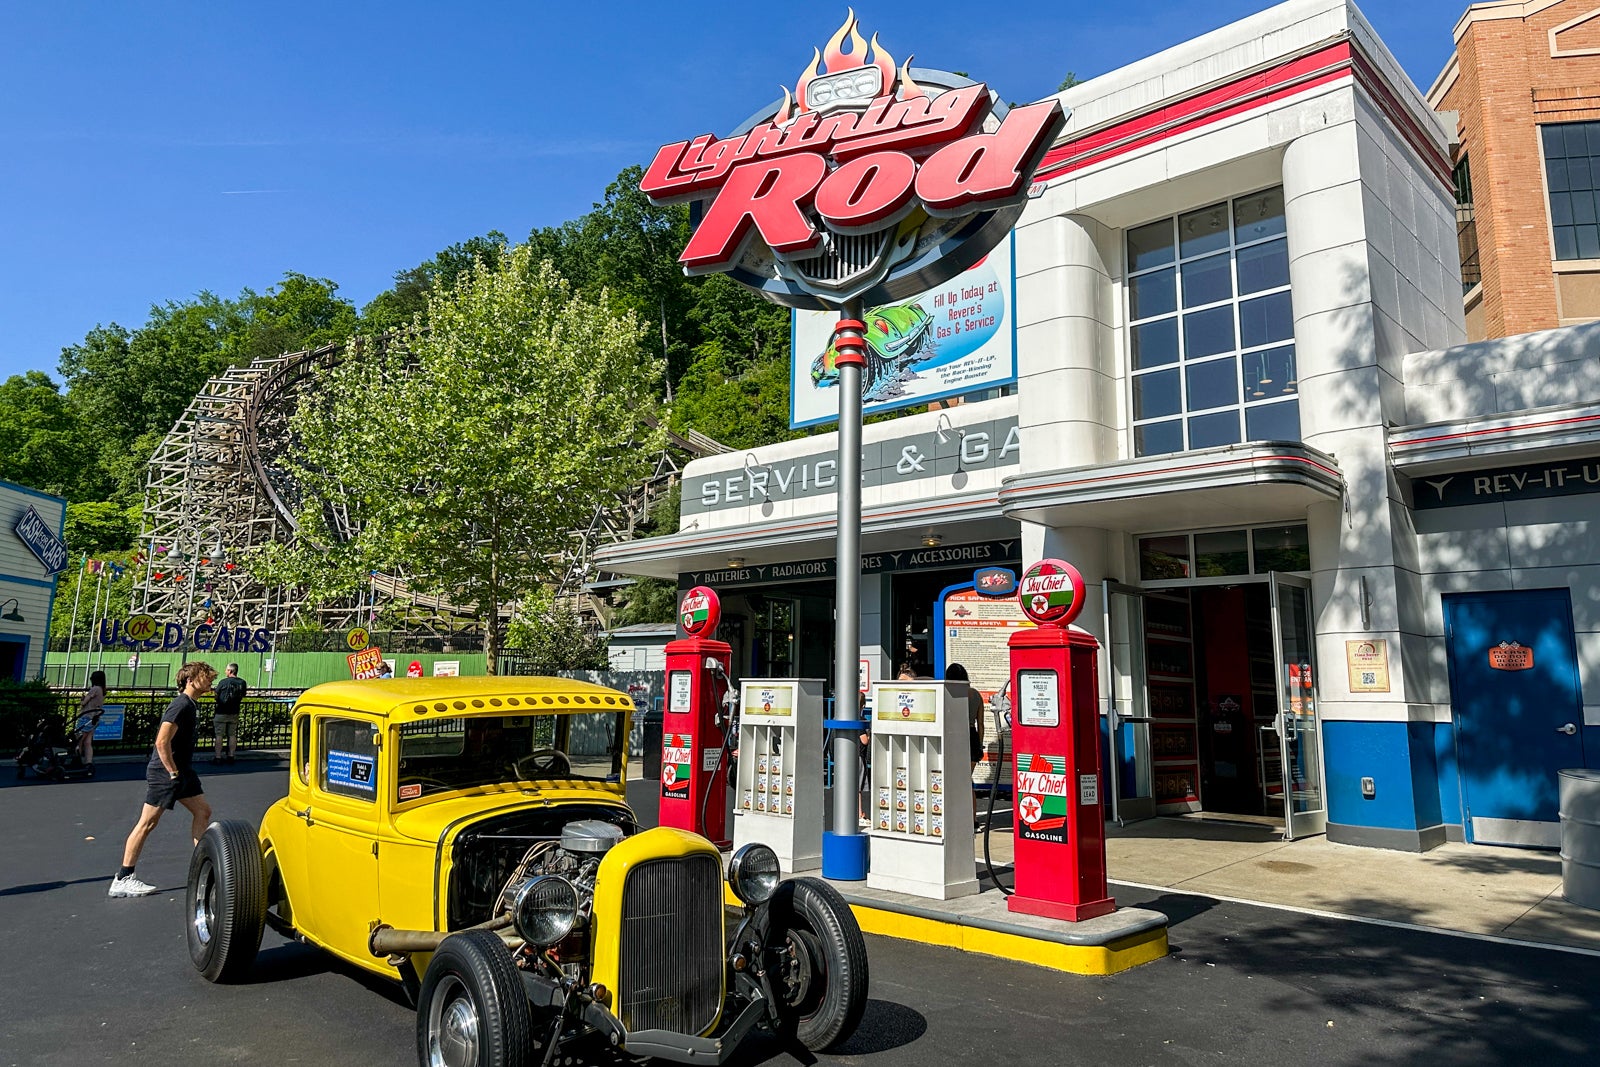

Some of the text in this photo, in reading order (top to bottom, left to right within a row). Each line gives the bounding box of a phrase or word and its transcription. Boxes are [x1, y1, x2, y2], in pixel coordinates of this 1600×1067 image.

[638, 82, 990, 198] Lightning
[678, 98, 1062, 264] Rod
[934, 280, 998, 308] Fill Up Today at
[948, 302, 982, 321] Revere's
[937, 315, 995, 339] Gas & Service
[701, 454, 865, 507] SERVIC
[896, 444, 926, 475] &
[20, 510, 44, 545] CASH
[42, 538, 66, 570] CARS
[704, 544, 992, 584] BATTERIES RADIATORS RES ACCESSORIES
[1027, 575, 1066, 592] Sky Chief
[99, 617, 271, 653] UD CARS
[131, 618, 151, 637] OK
[350, 630, 366, 647] OK
[351, 650, 377, 664] DRIVE
[356, 659, 378, 674] BUY
[675, 748, 691, 763] Chief
[1018, 772, 1035, 793] Sky
[1038, 774, 1067, 794] Chief
[665, 791, 687, 799] GASOLINE
[1083, 790, 1096, 798] LEAD
[1025, 831, 1063, 842] GASOLINE
